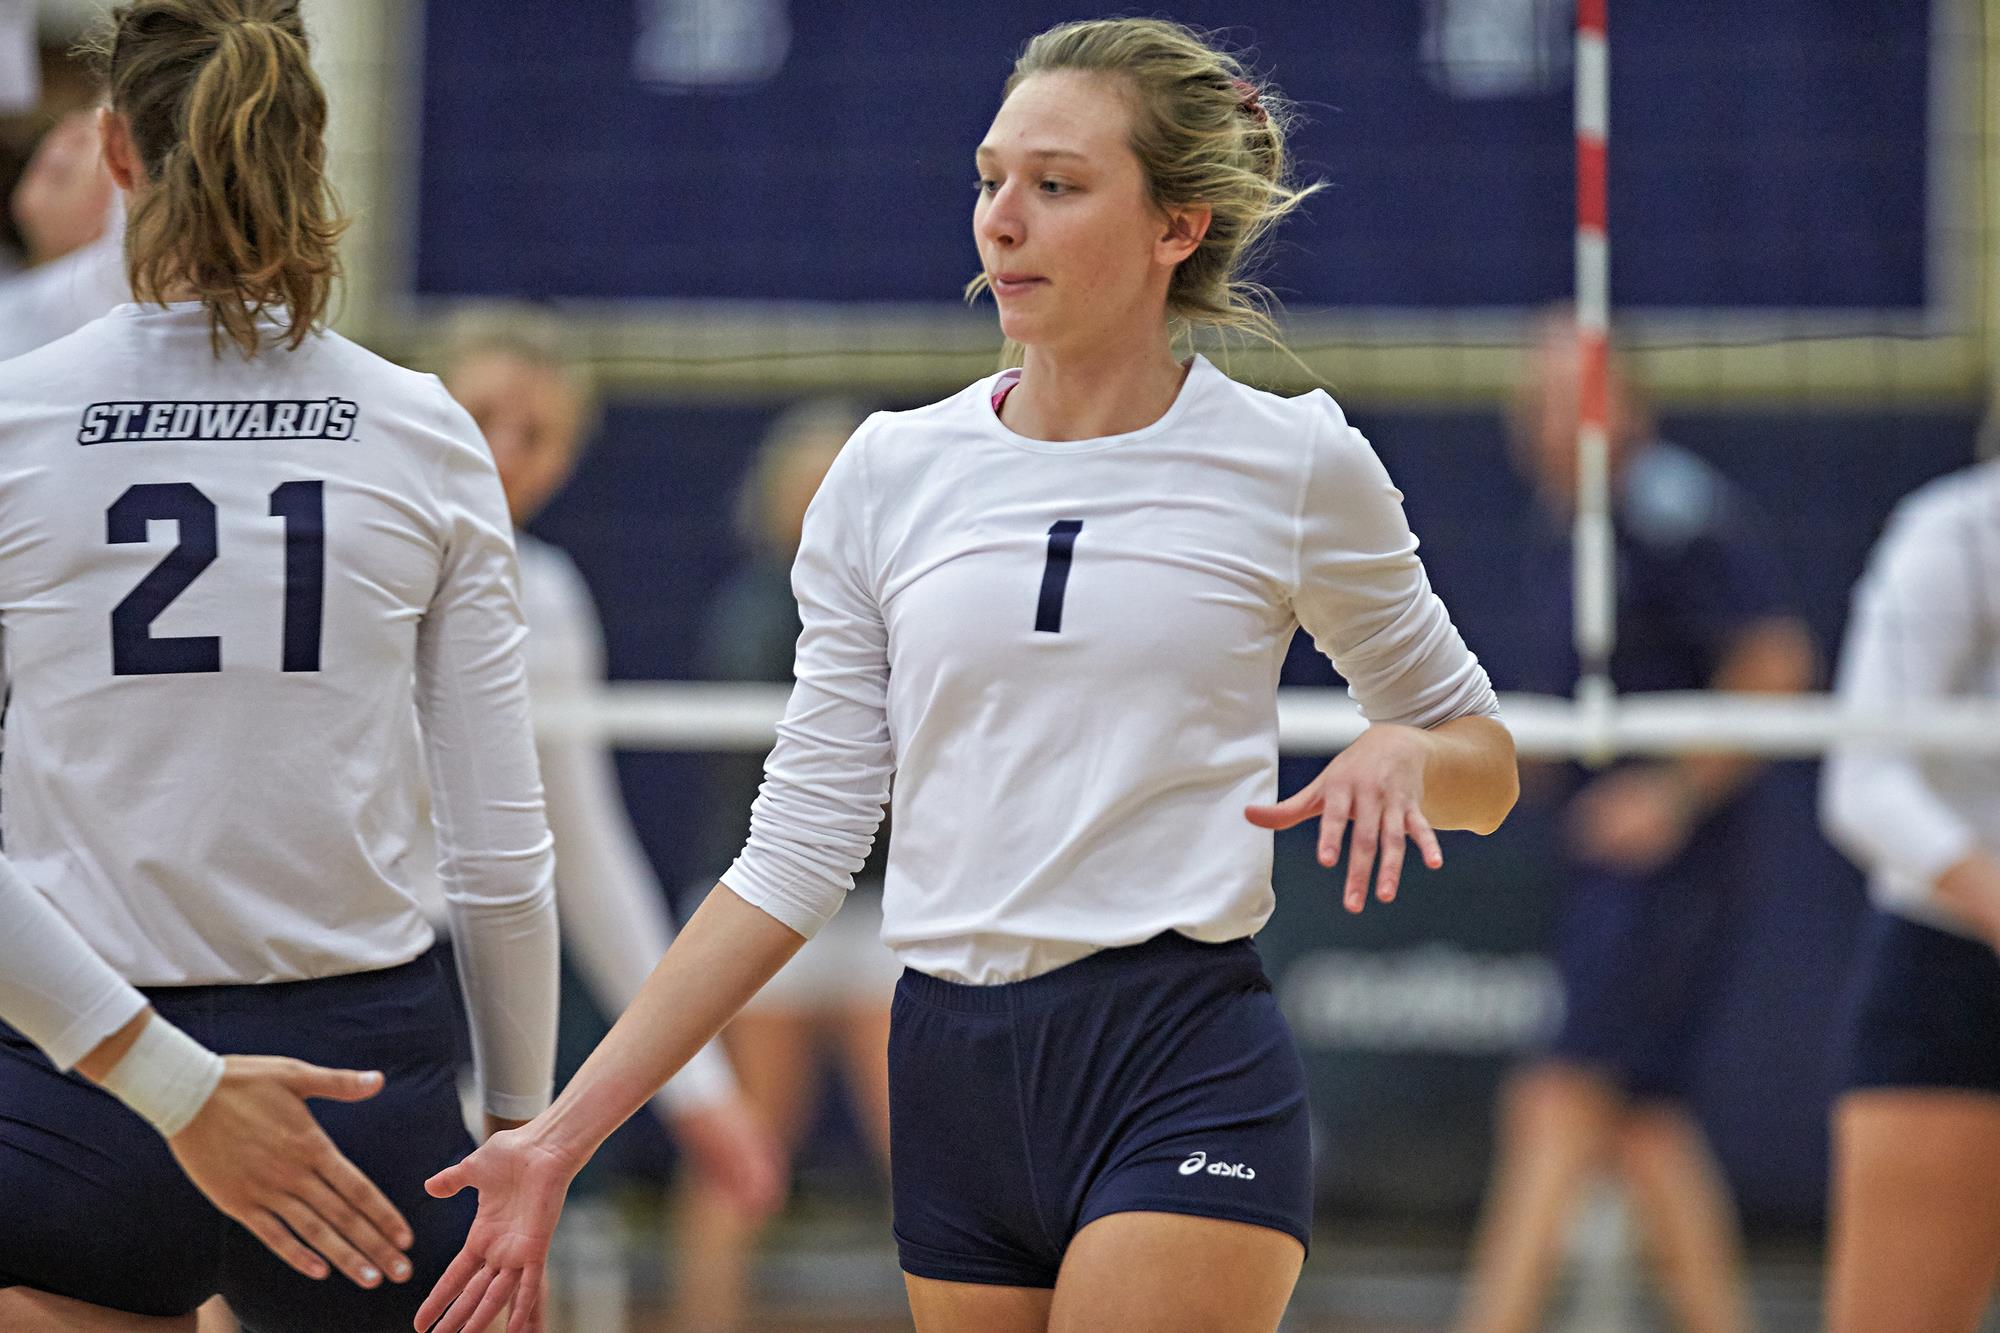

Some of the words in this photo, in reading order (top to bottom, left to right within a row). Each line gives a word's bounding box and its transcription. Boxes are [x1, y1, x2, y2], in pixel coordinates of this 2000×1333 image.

[106, 480, 325, 675] 21
[1034, 520, 1084, 633] 1
[1206, 1161, 1256, 1180] asics
